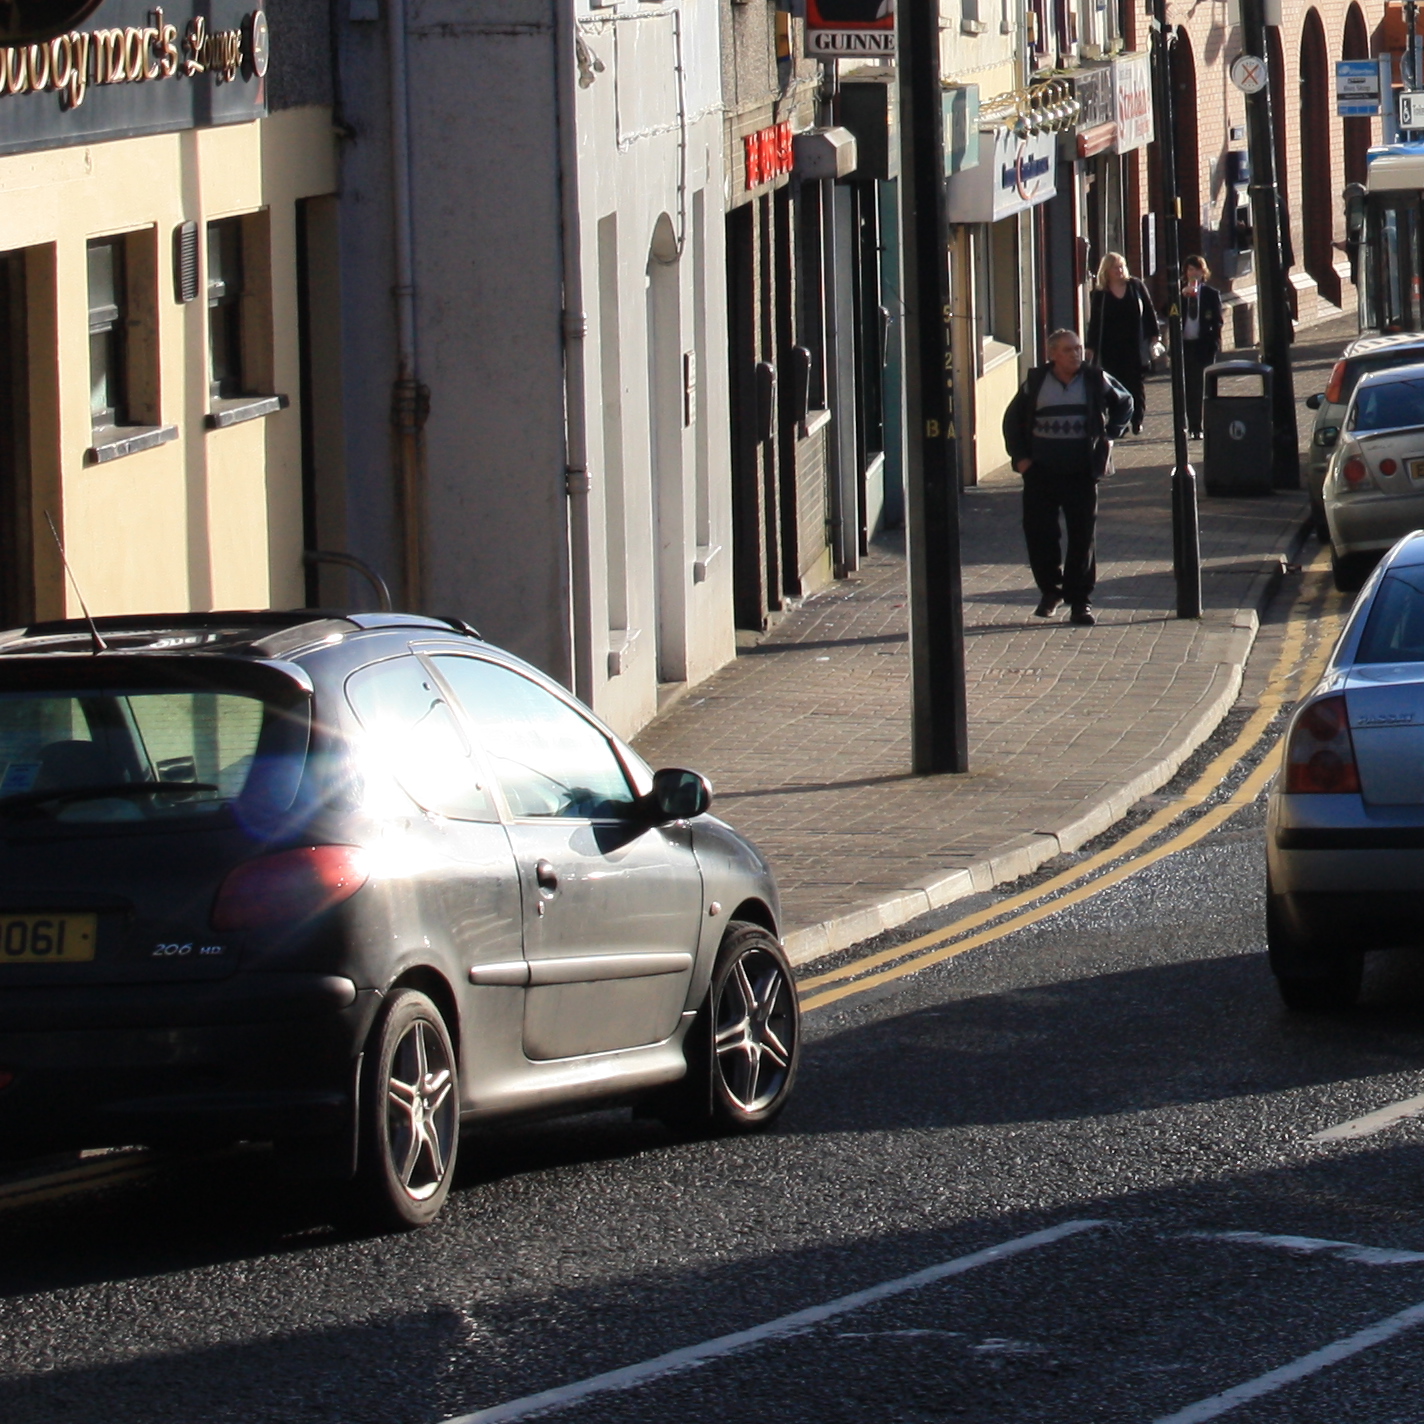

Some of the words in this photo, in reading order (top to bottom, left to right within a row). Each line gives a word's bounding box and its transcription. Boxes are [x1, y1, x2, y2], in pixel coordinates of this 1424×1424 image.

[184, 15, 243, 82] Lounge
[815, 32, 895, 51] GUINNE
[152, 942, 194, 956] 206
